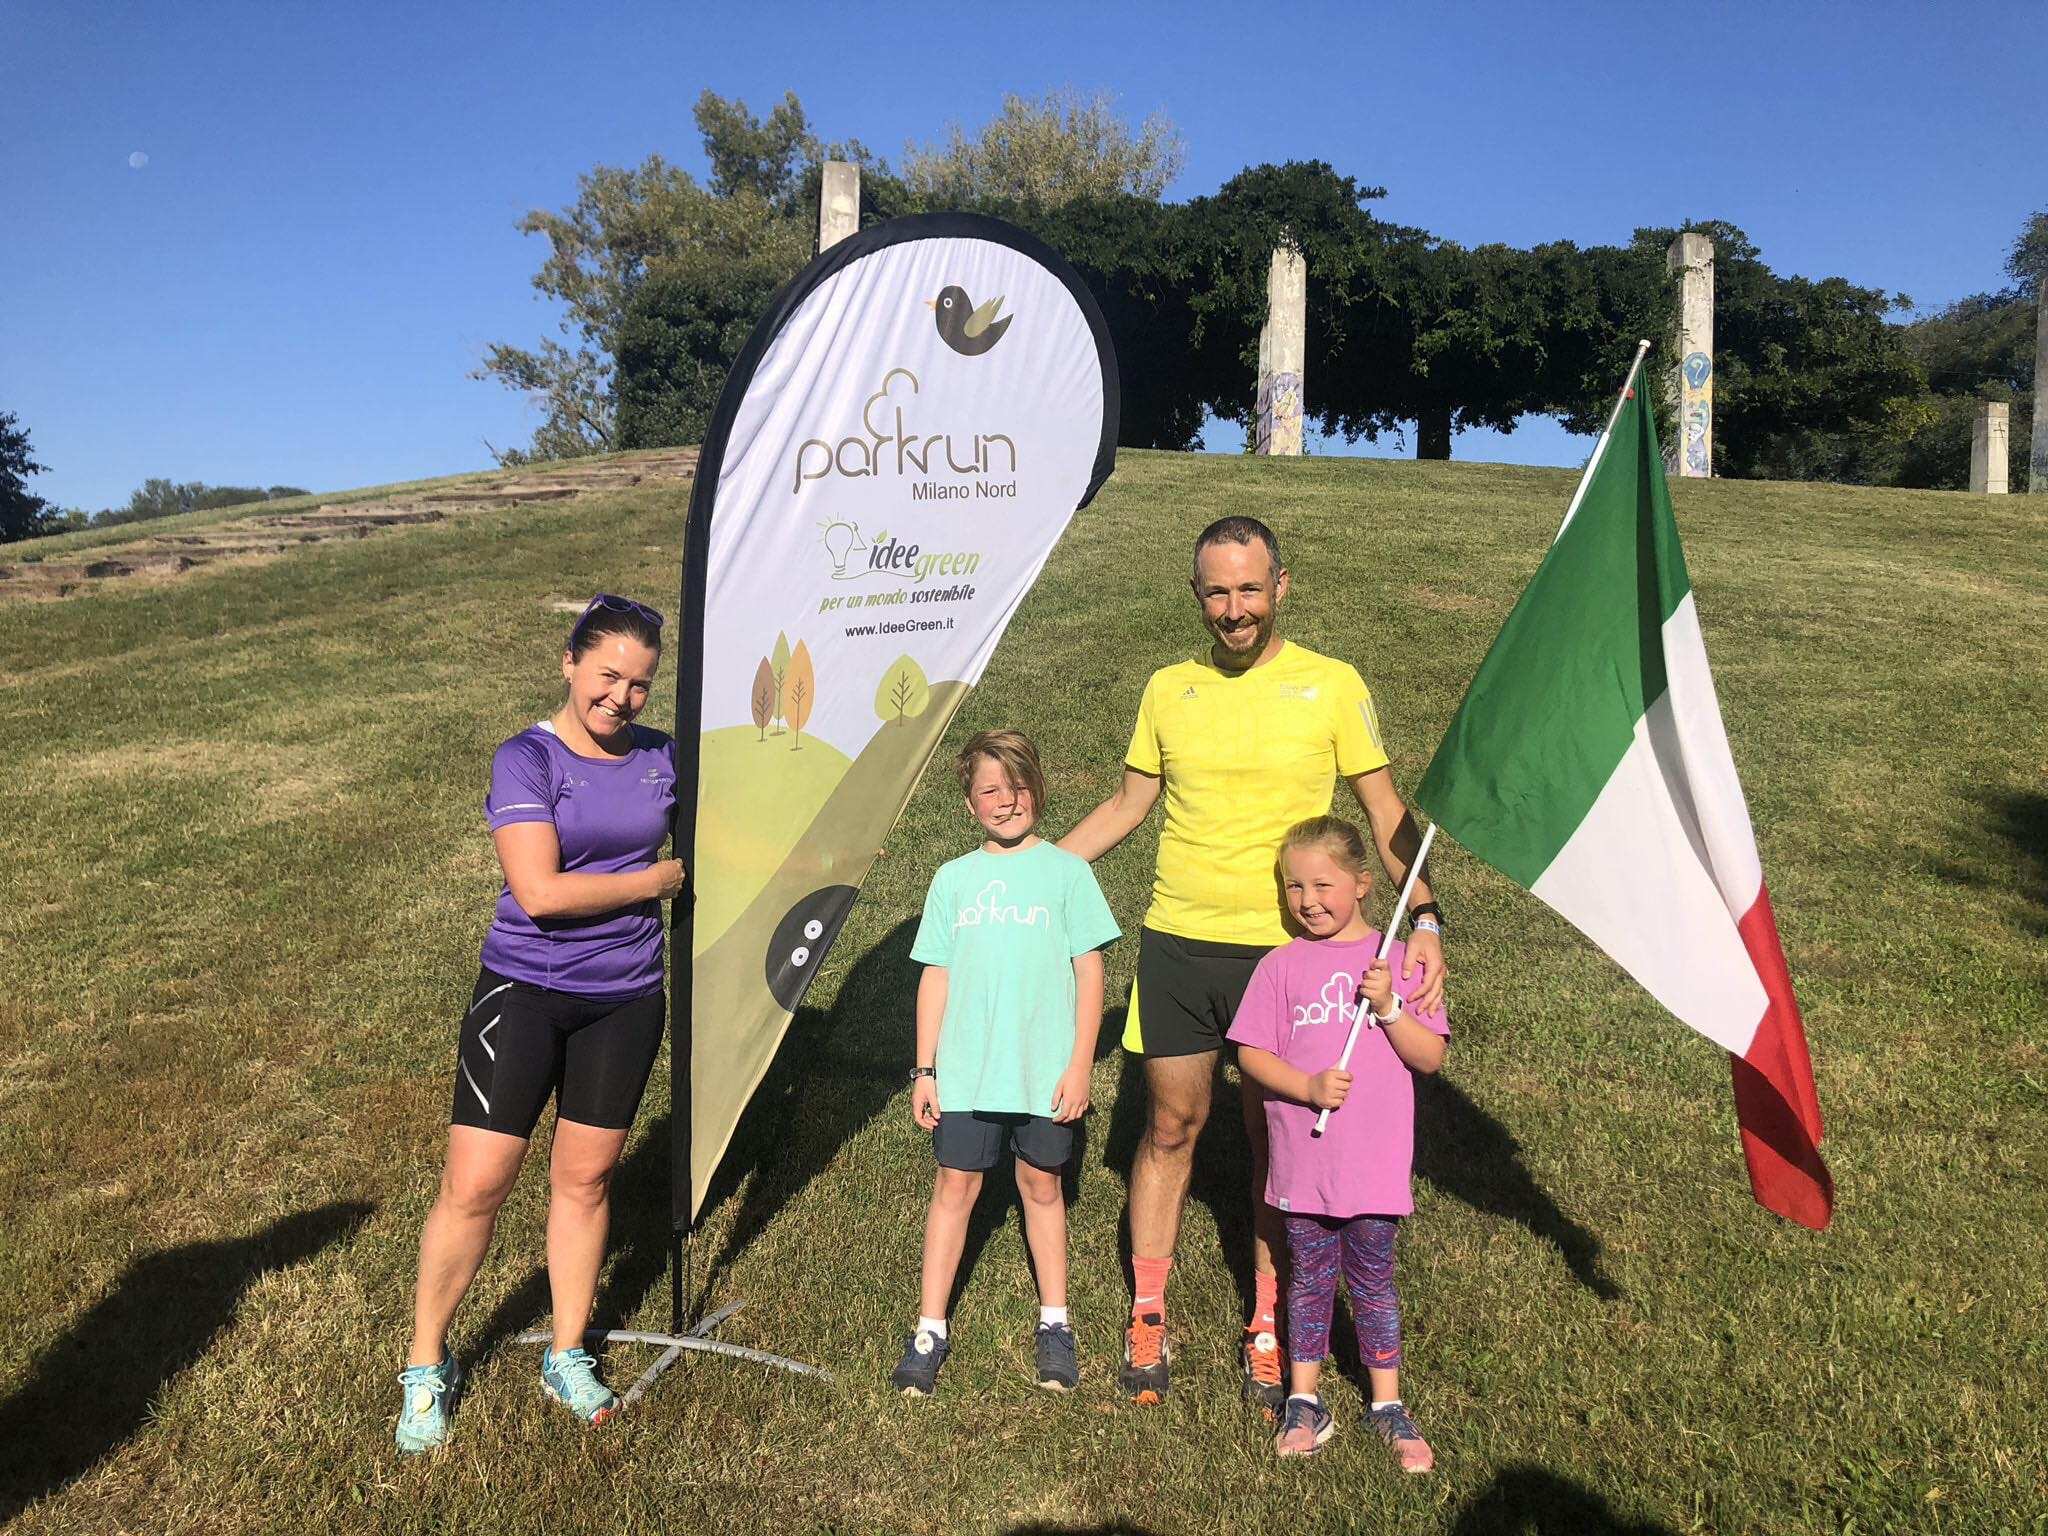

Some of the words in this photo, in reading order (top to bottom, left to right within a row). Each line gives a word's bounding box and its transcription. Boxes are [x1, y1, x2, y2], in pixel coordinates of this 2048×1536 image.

[793, 367, 1017, 494] parkrun
[912, 482, 970, 500] Milano
[975, 480, 1016, 498] Nord
[818, 594, 844, 615] per
[846, 593, 862, 609] un
[865, 588, 908, 607] mondo
[909, 583, 976, 604] sostenibile
[845, 617, 954, 637] www.IdeeGreen.it
